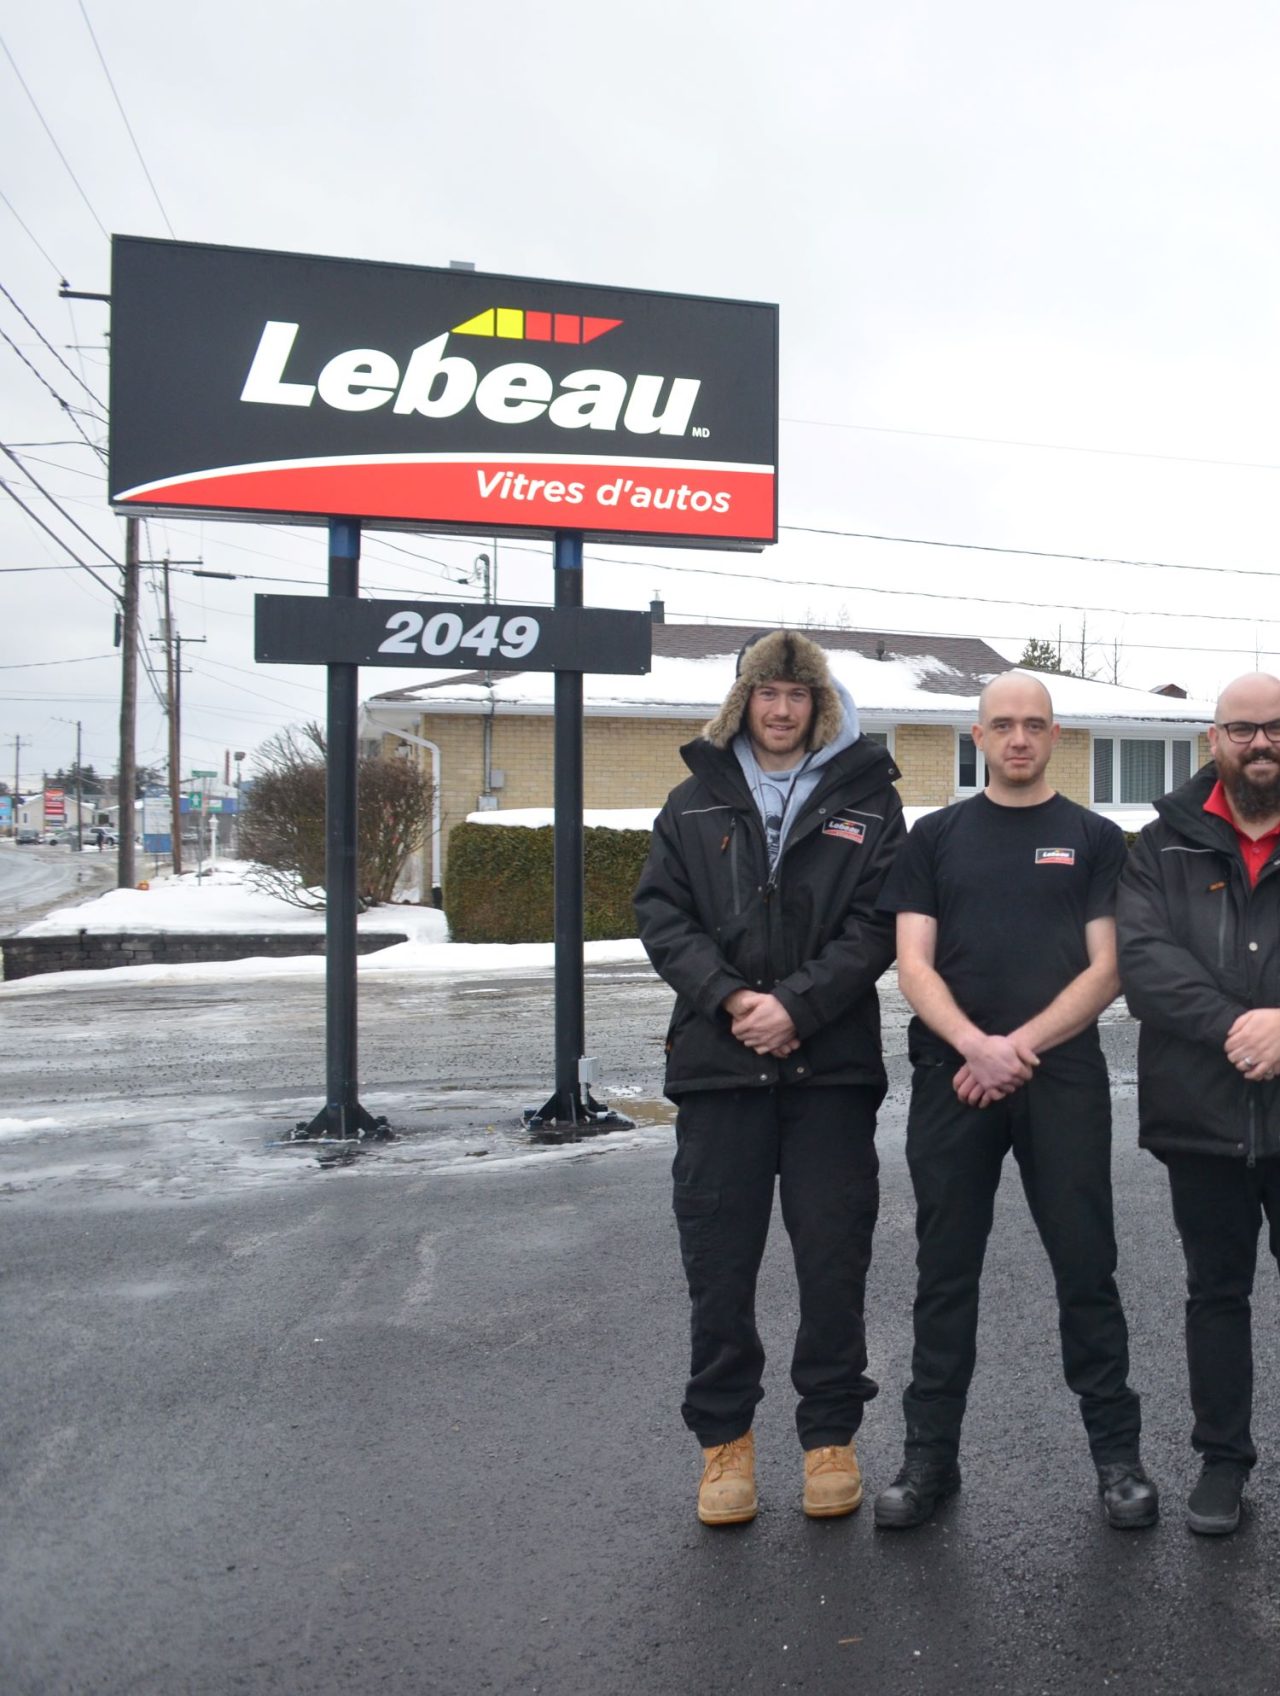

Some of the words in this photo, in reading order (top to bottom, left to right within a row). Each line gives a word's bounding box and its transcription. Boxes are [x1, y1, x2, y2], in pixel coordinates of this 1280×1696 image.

[240, 320, 701, 436] Lebeau
[691, 426, 711, 438] MD
[476, 470, 585, 504] Vitres
[596, 478, 731, 513] d'autos
[377, 610, 540, 659] 2049
